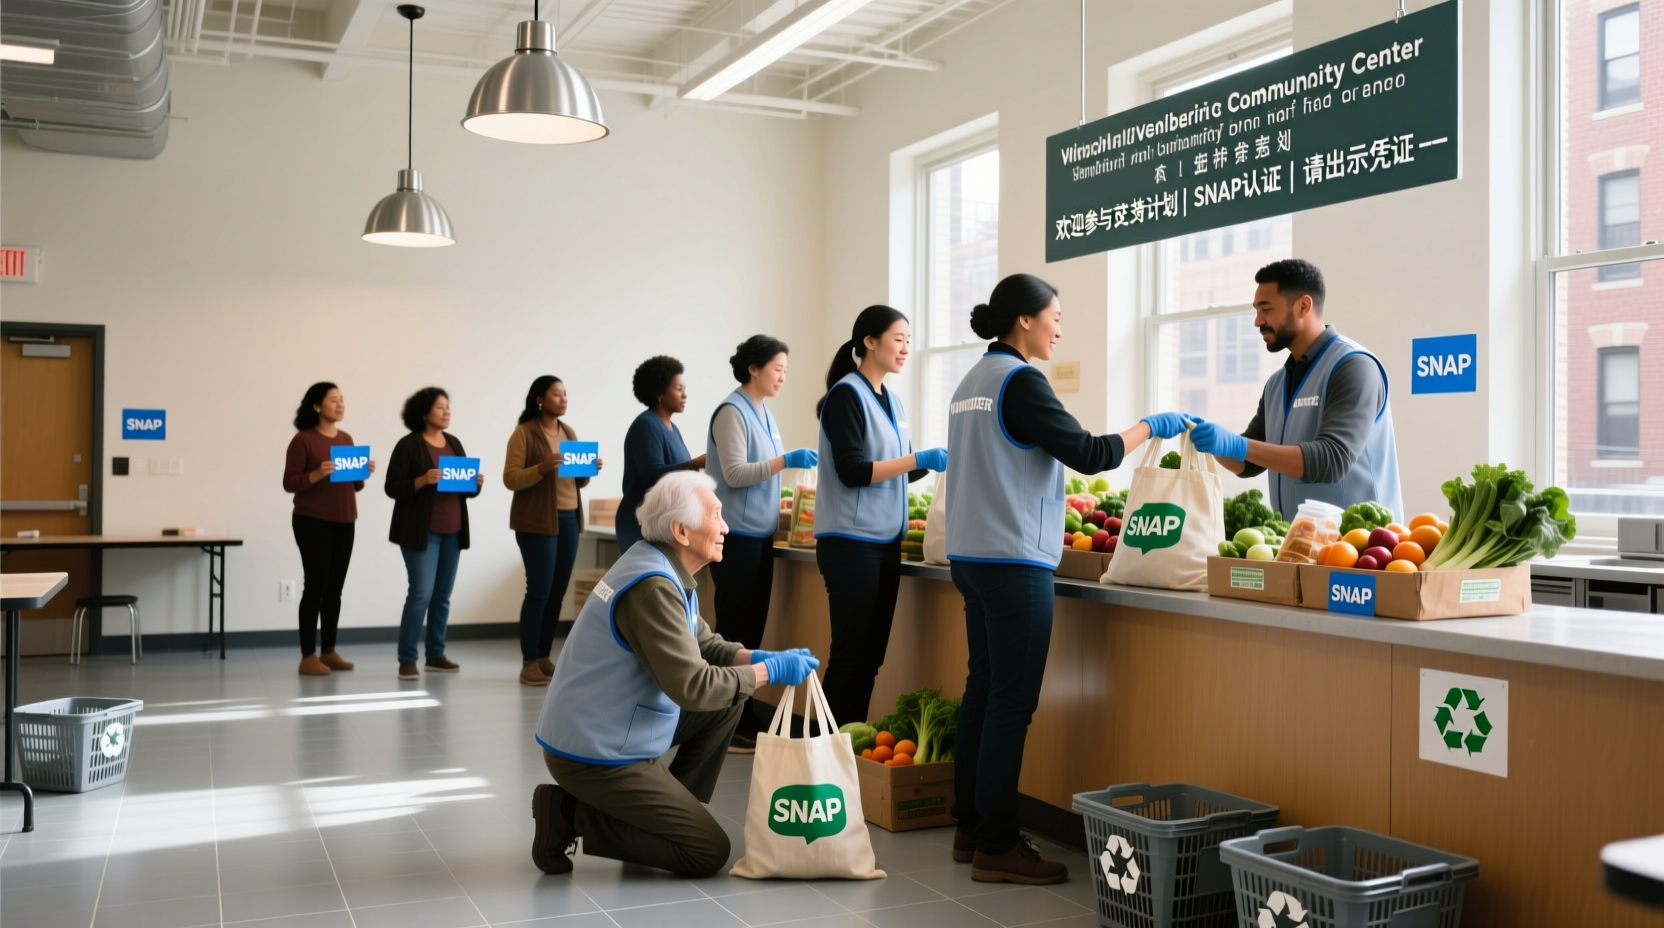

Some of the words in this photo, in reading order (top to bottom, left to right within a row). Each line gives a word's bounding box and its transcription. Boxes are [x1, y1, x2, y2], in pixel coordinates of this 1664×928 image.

[1351, 37, 1424, 75] Center
[1302, 133, 1415, 185] 请出示凭证
[1417, 353, 1472, 377] SNAP
[126, 418, 163, 431] SNAP
[334, 456, 367, 471] SNAP
[563, 452, 597, 466] SNAP
[442, 467, 477, 481] SNAP
[1126, 515, 1181, 537] SNAP
[1331, 584, 1373, 606] SNAP
[773, 797, 843, 824] SNAP
